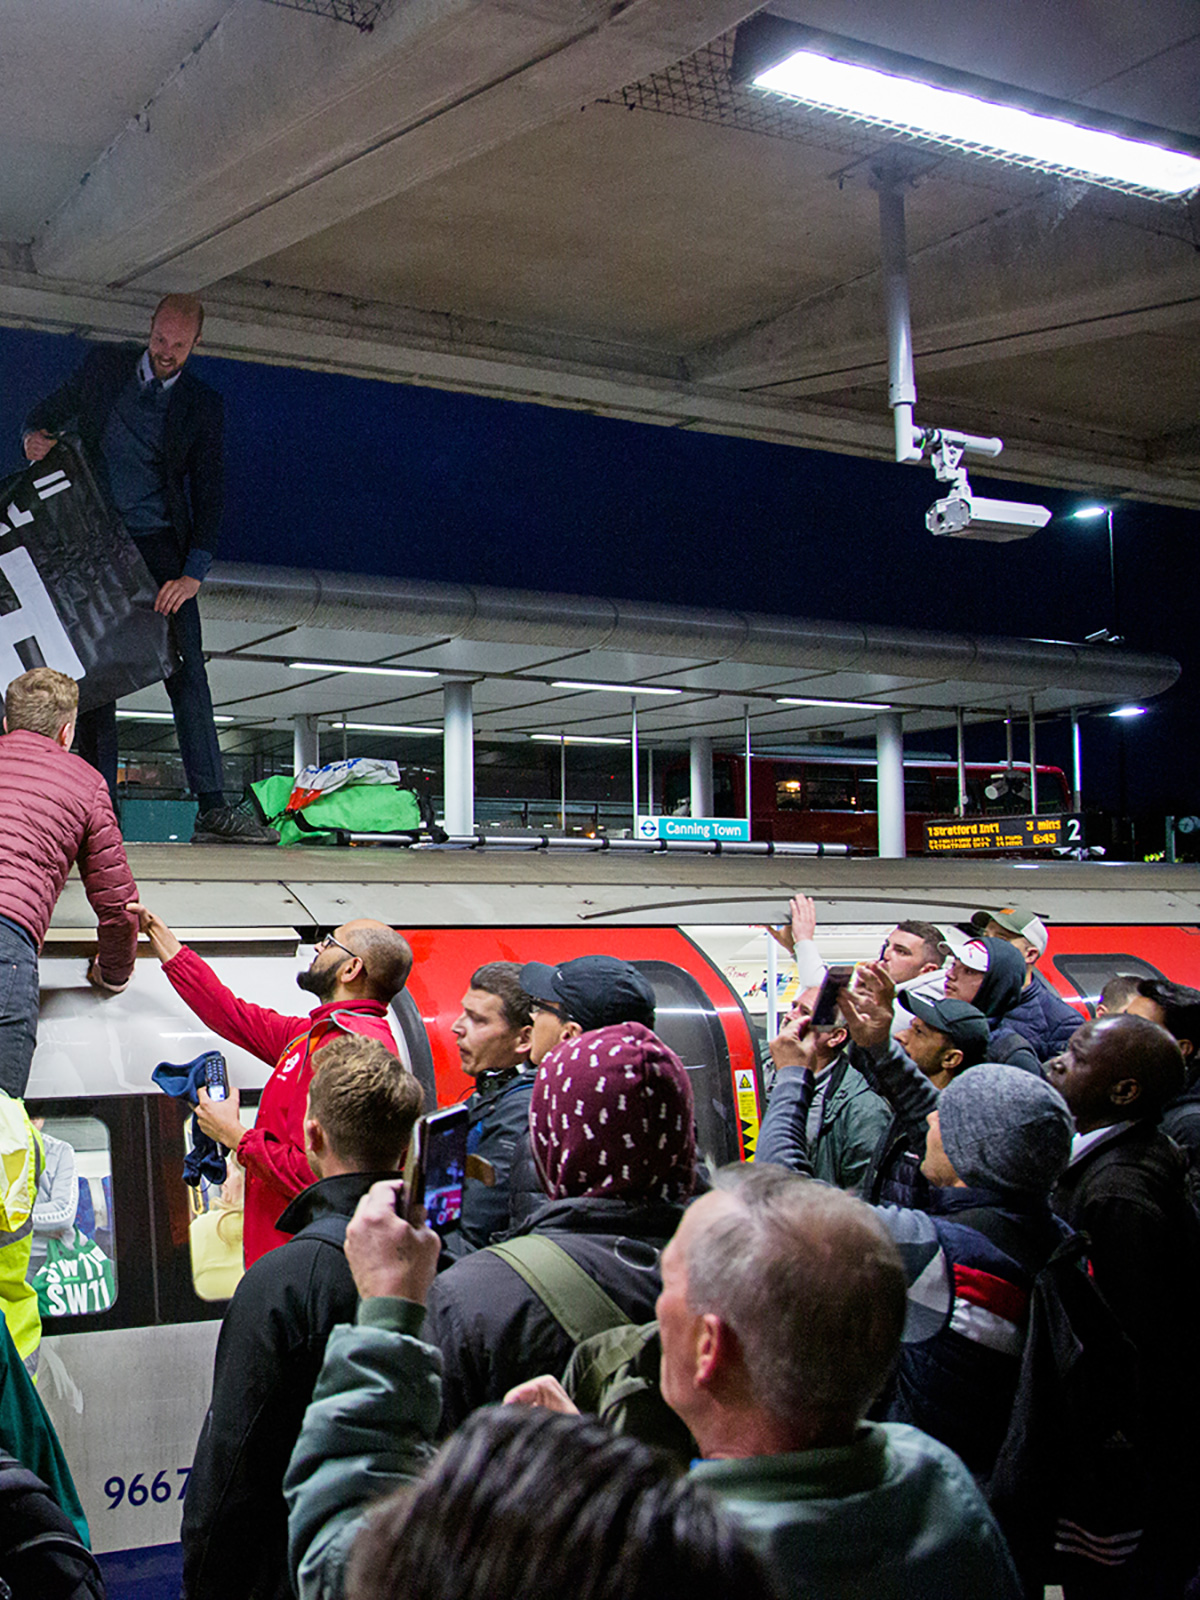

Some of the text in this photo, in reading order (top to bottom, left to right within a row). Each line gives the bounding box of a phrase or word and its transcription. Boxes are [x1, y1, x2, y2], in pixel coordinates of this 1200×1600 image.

[666, 821, 741, 838] Canning Town
[1026, 821, 1034, 831] 3
[1037, 820, 1062, 831] mins
[1067, 819, 1082, 841] 2
[46, 1277, 112, 1316] SW11
